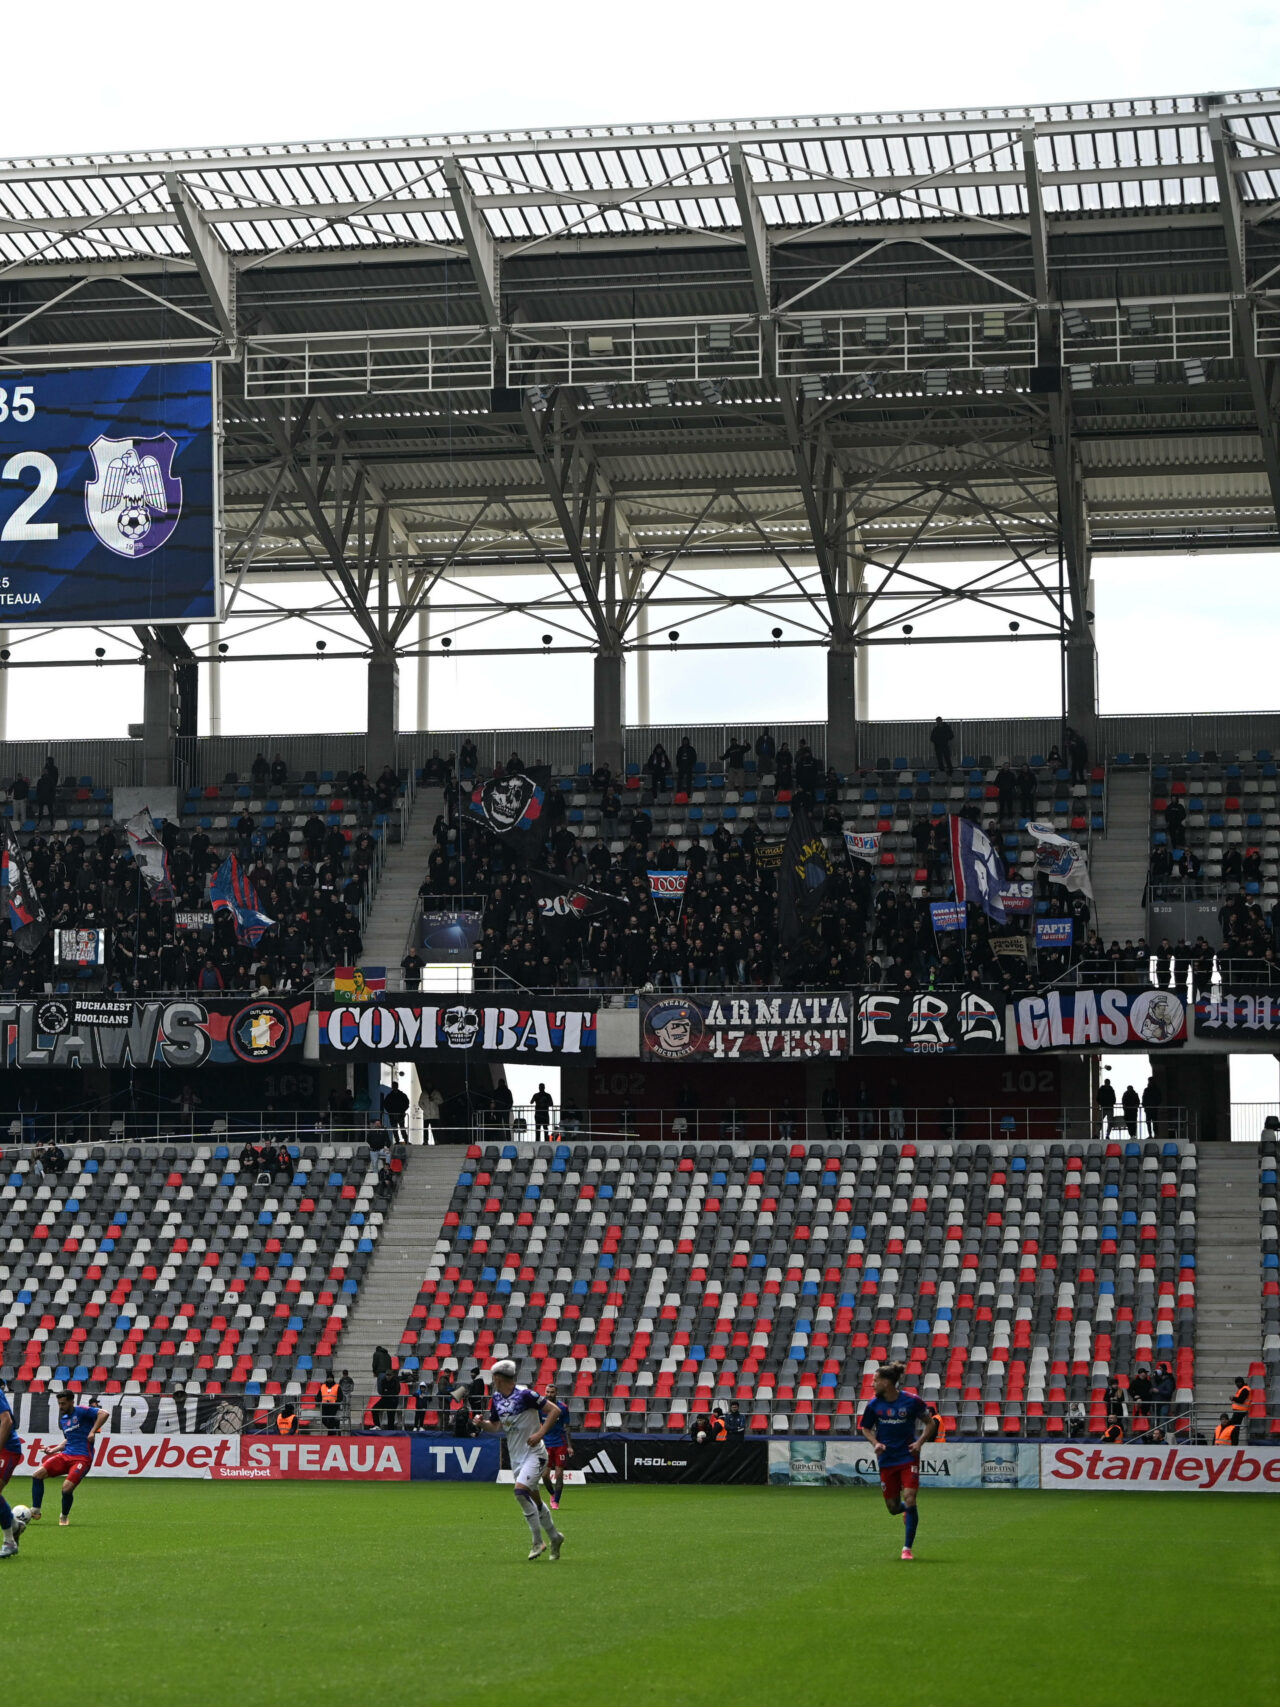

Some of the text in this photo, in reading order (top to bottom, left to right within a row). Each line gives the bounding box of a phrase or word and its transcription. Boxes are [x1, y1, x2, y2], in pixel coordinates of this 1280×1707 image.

[125, 542, 144, 551] 19
[75, 1001, 132, 1011] BUCHAREST
[705, 997, 848, 1025] ARMATA
[74, 1014, 129, 1024] HOOLIGANS
[1019, 989, 1129, 1050] GLAS
[708, 1029, 846, 1058] 47 VEST
[913, 1042, 944, 1053] 2006
[1001, 1071, 1054, 1092] 102
[248, 1443, 402, 1472] STEAUA
[429, 1446, 482, 1474] TV
[855, 1458, 951, 1476] CAINA
[220, 1467, 271, 1477] Stanleybet
